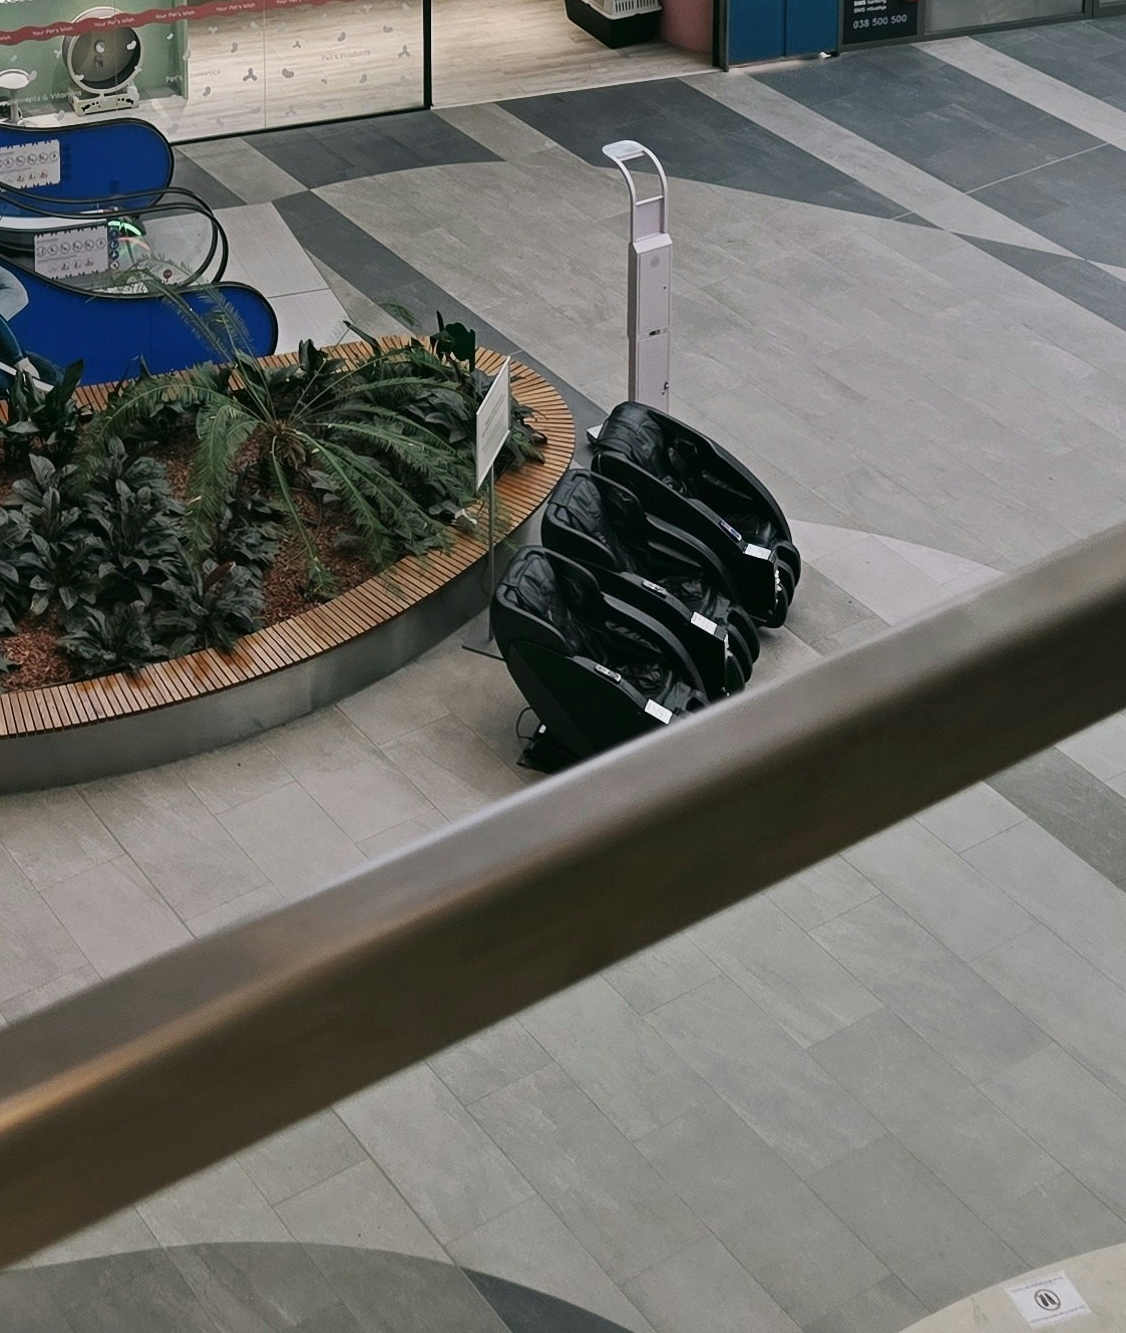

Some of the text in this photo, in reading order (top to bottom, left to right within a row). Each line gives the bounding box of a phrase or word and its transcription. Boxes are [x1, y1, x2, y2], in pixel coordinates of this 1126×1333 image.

[853, 14, 908, 29] 038 500 500
[186, 69, 221, 79] osmetics
